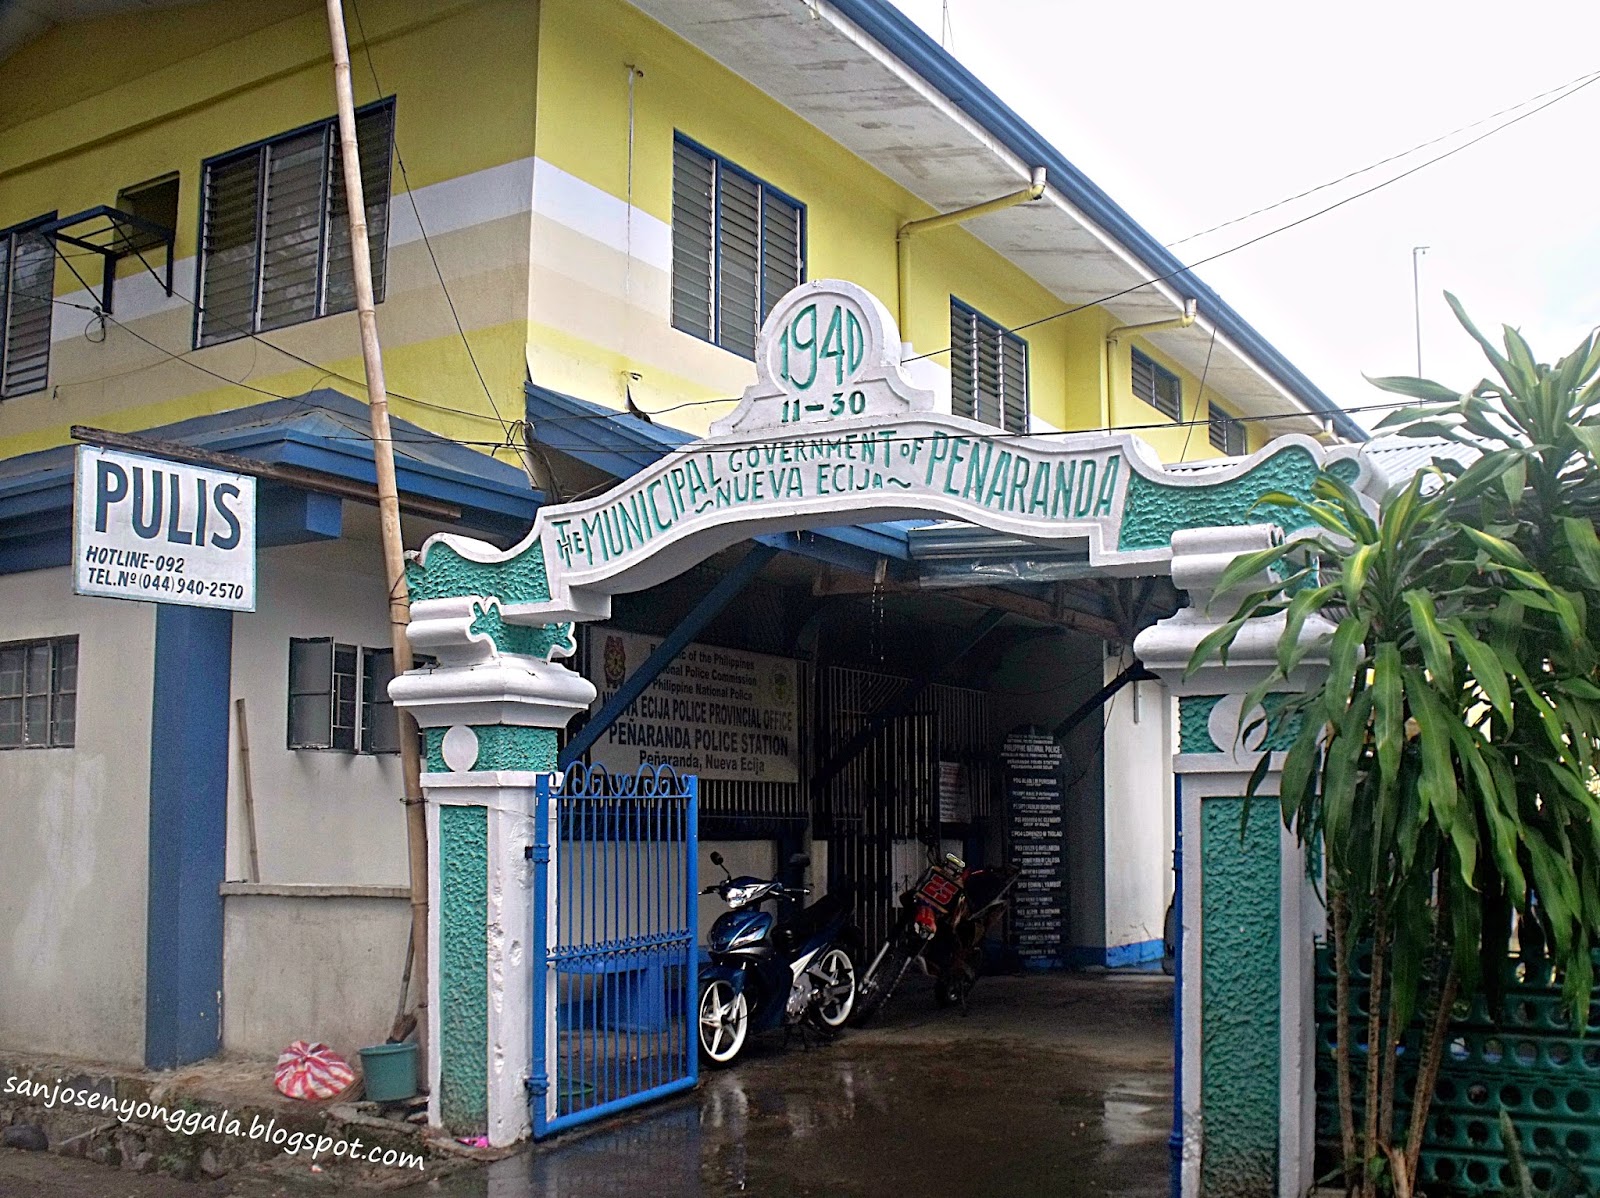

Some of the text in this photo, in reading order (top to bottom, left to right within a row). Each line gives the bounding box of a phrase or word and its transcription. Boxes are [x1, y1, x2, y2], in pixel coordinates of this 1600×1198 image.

[780, 303, 865, 391] 1940
[780, 390, 866, 423] 11-30
[94, 459, 242, 550] PULIS
[551, 519, 584, 568] THE
[581, 454, 722, 565] MUNICIPAL
[728, 430, 897, 472] GOVERNMENT
[85, 545, 185, 574] HOTLINE-092
[685, 666, 709, 680] Police
[711, 669, 757, 686] Commission
[689, 650, 699, 662] of
[700, 651, 712, 664] the
[713, 653, 755, 670] Philippines
[652, 679, 753, 701] Philippine National Police
[641, 697, 671, 720] ECIJA
[672, 699, 707, 724] POLICE
[708, 702, 762, 730] PROVINCIAL
[763, 709, 793, 732] OFFICE
[609, 718, 789, 757] PEÑARANDA POLICE STATION
[705, 754, 737, 771] Nueva
[740, 756, 766, 776] Ecija
